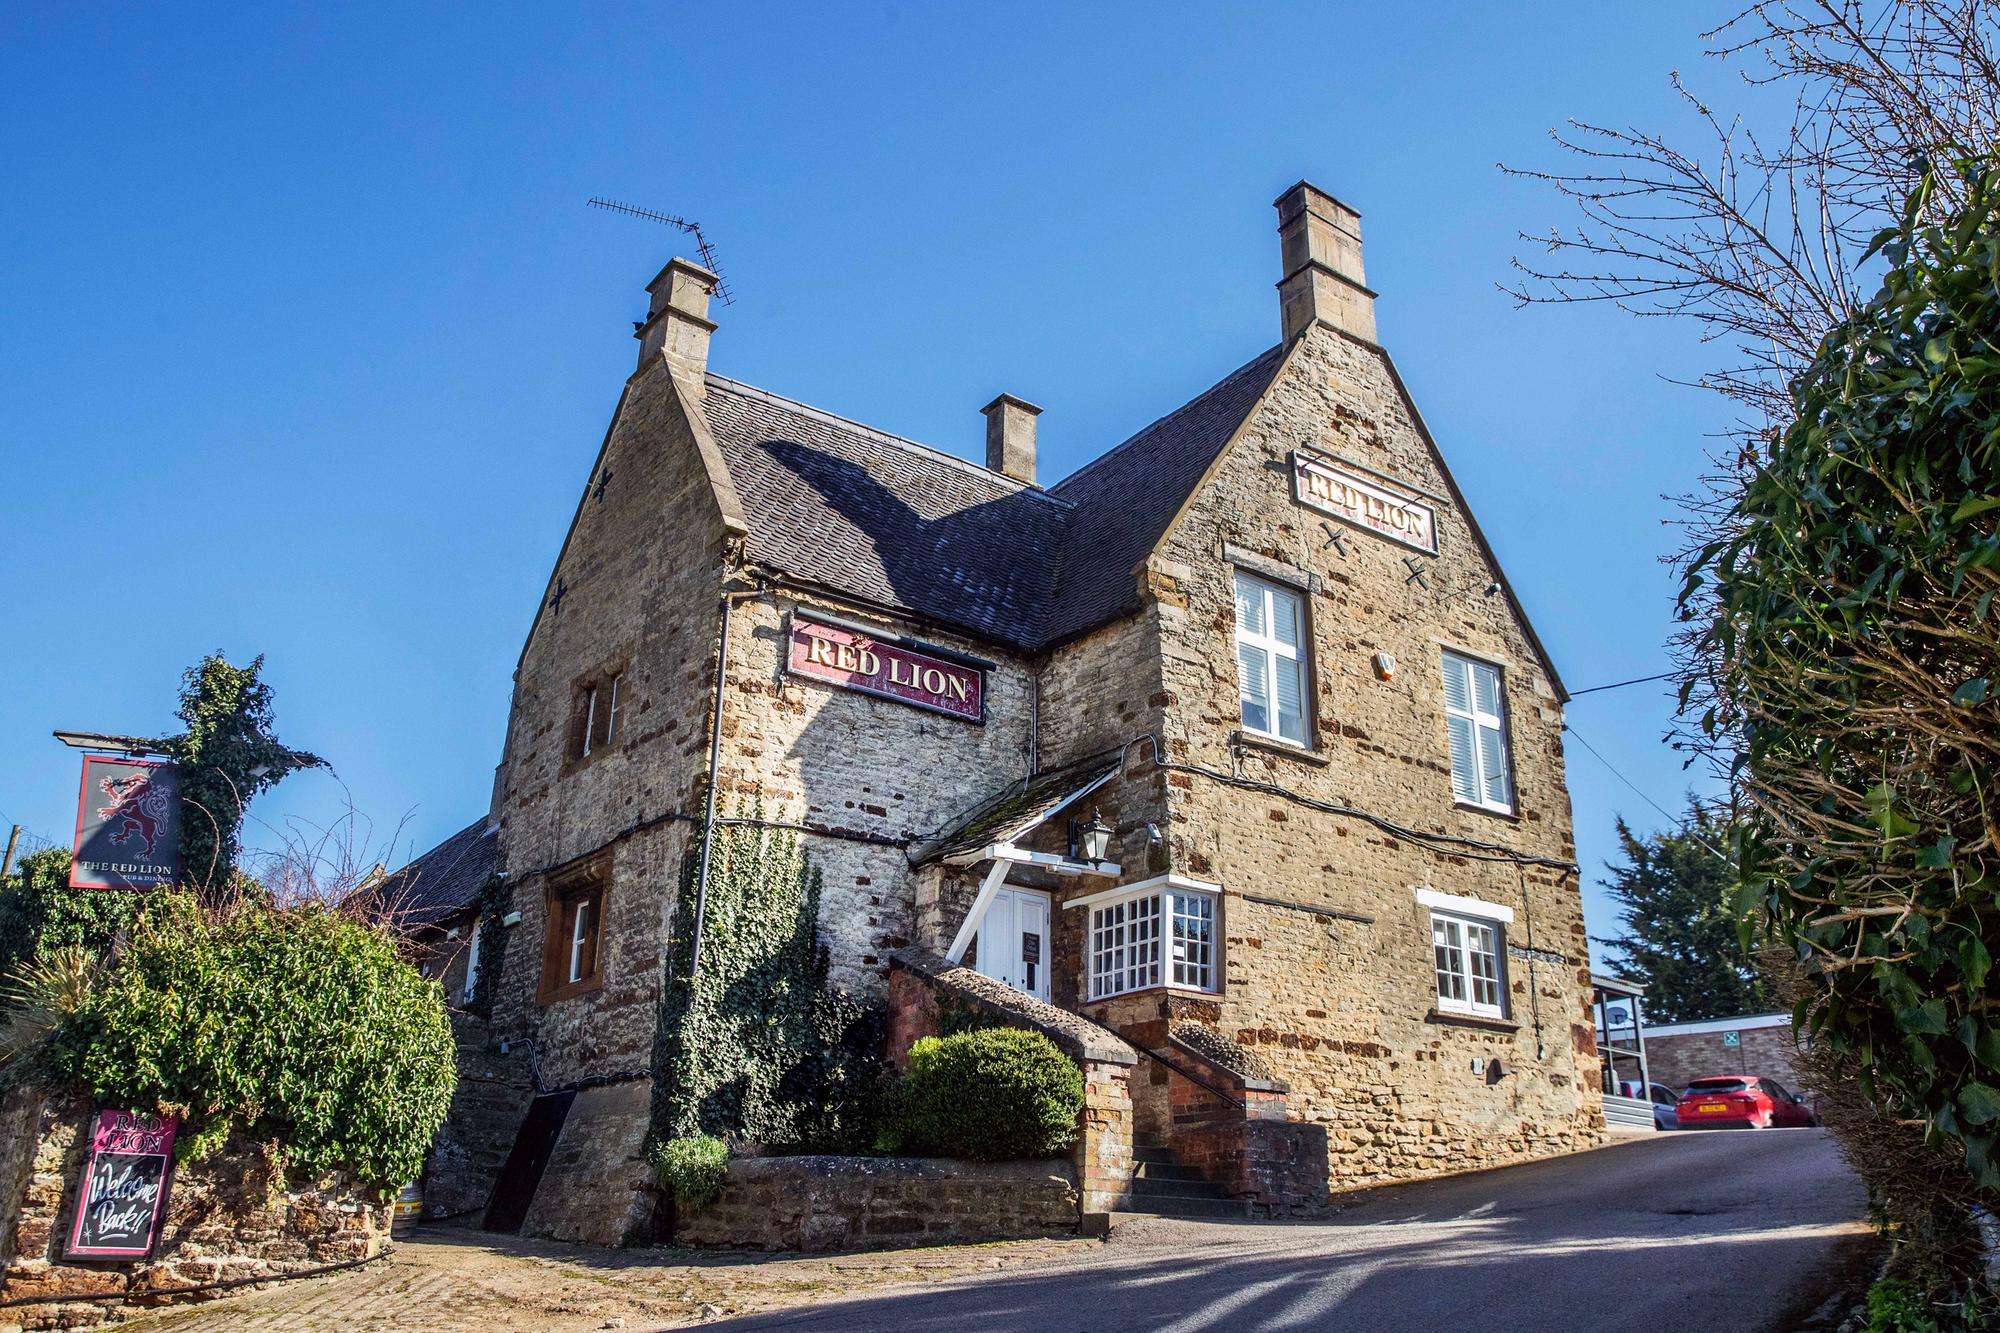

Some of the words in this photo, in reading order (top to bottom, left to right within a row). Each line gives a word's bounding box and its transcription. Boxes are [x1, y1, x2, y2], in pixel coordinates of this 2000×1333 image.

[1308, 471, 1358, 510] RED
[1363, 493, 1423, 538] LION
[805, 635, 880, 676] RED
[888, 657, 968, 701] LION
[81, 861, 109, 871] THE
[111, 863, 137, 872] RED
[140, 865, 172, 874] LION
[116, 1115, 162, 1132] RED
[107, 1132, 164, 1152] LION
[90, 1162, 159, 1204] Welcome
[92, 1200, 151, 1235] Back!!
